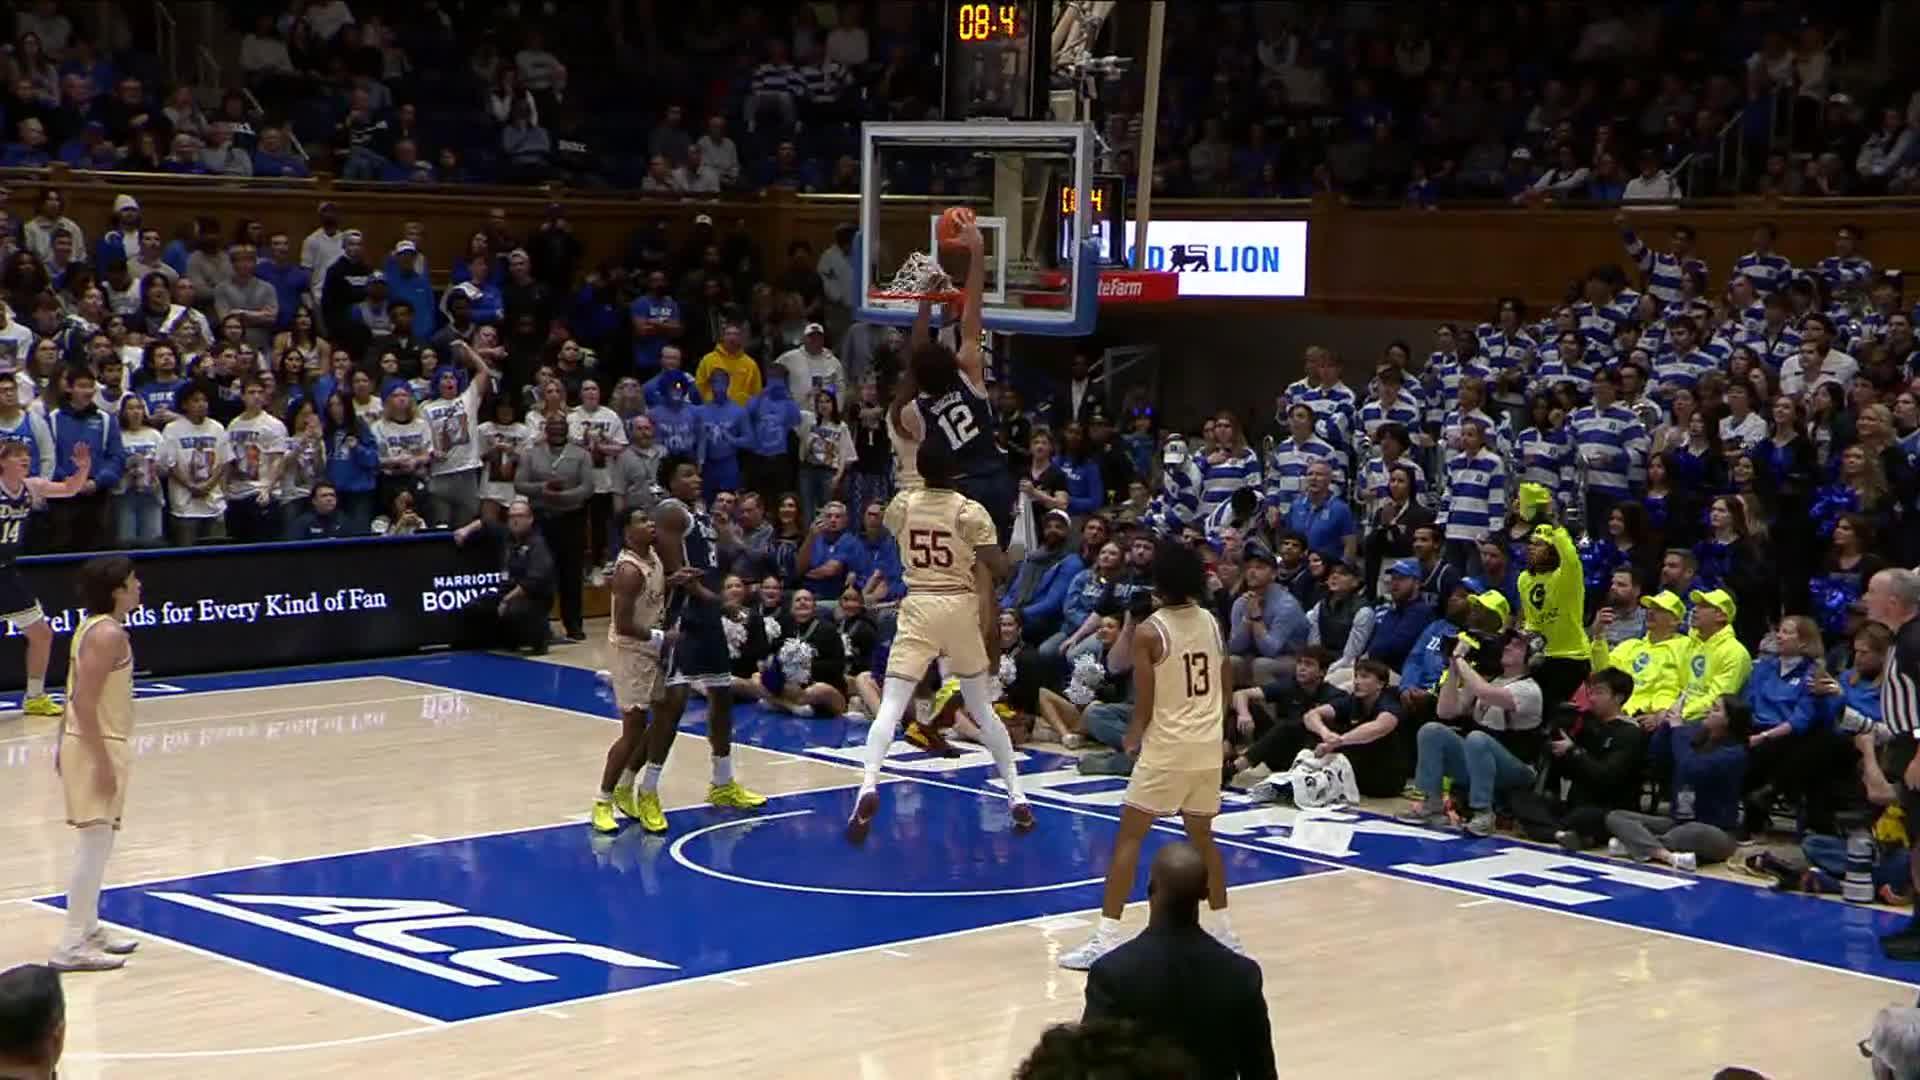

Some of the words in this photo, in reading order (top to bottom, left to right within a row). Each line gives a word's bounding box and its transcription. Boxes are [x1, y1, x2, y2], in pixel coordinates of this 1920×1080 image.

[960, 5, 1015, 39] 08.4
[1214, 245, 1280, 272] LION
[938, 404, 980, 451] 12
[0, 520, 20, 544] 14
[909, 529, 954, 568] 55
[433, 571, 502, 588] MARRIOTT
[162, 602, 192, 624] for
[197, 599, 260, 622] Every
[265, 592, 320, 616] Kind
[324, 590, 344, 611] of
[349, 588, 387, 609] Fan
[1182, 652, 1209, 697] 13
[208, 892, 682, 984] ACC
